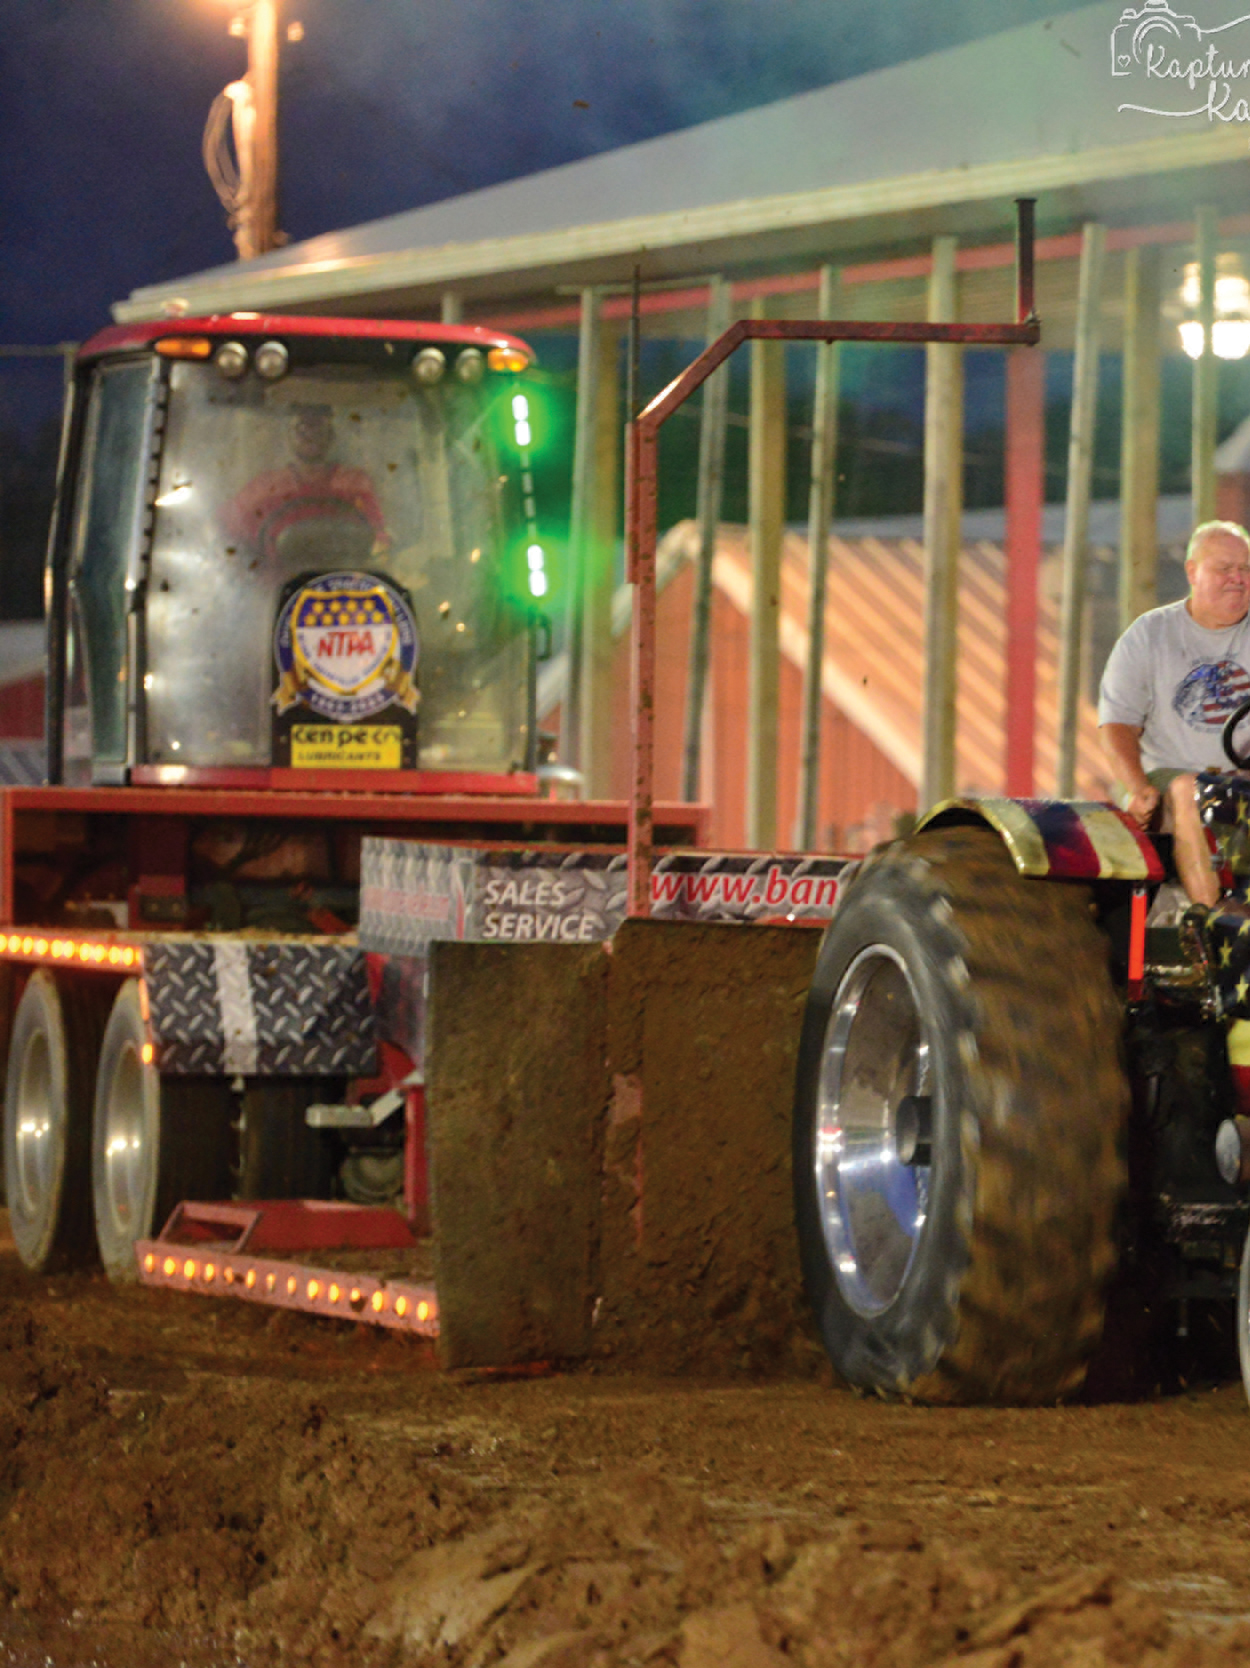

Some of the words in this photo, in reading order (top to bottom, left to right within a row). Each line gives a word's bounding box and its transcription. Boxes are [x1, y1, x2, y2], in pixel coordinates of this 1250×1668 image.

[318, 631, 376, 658] NTPA
[483, 879, 567, 907] SALES
[650, 866, 838, 906] www.ban
[483, 912, 596, 940] SERVICE
